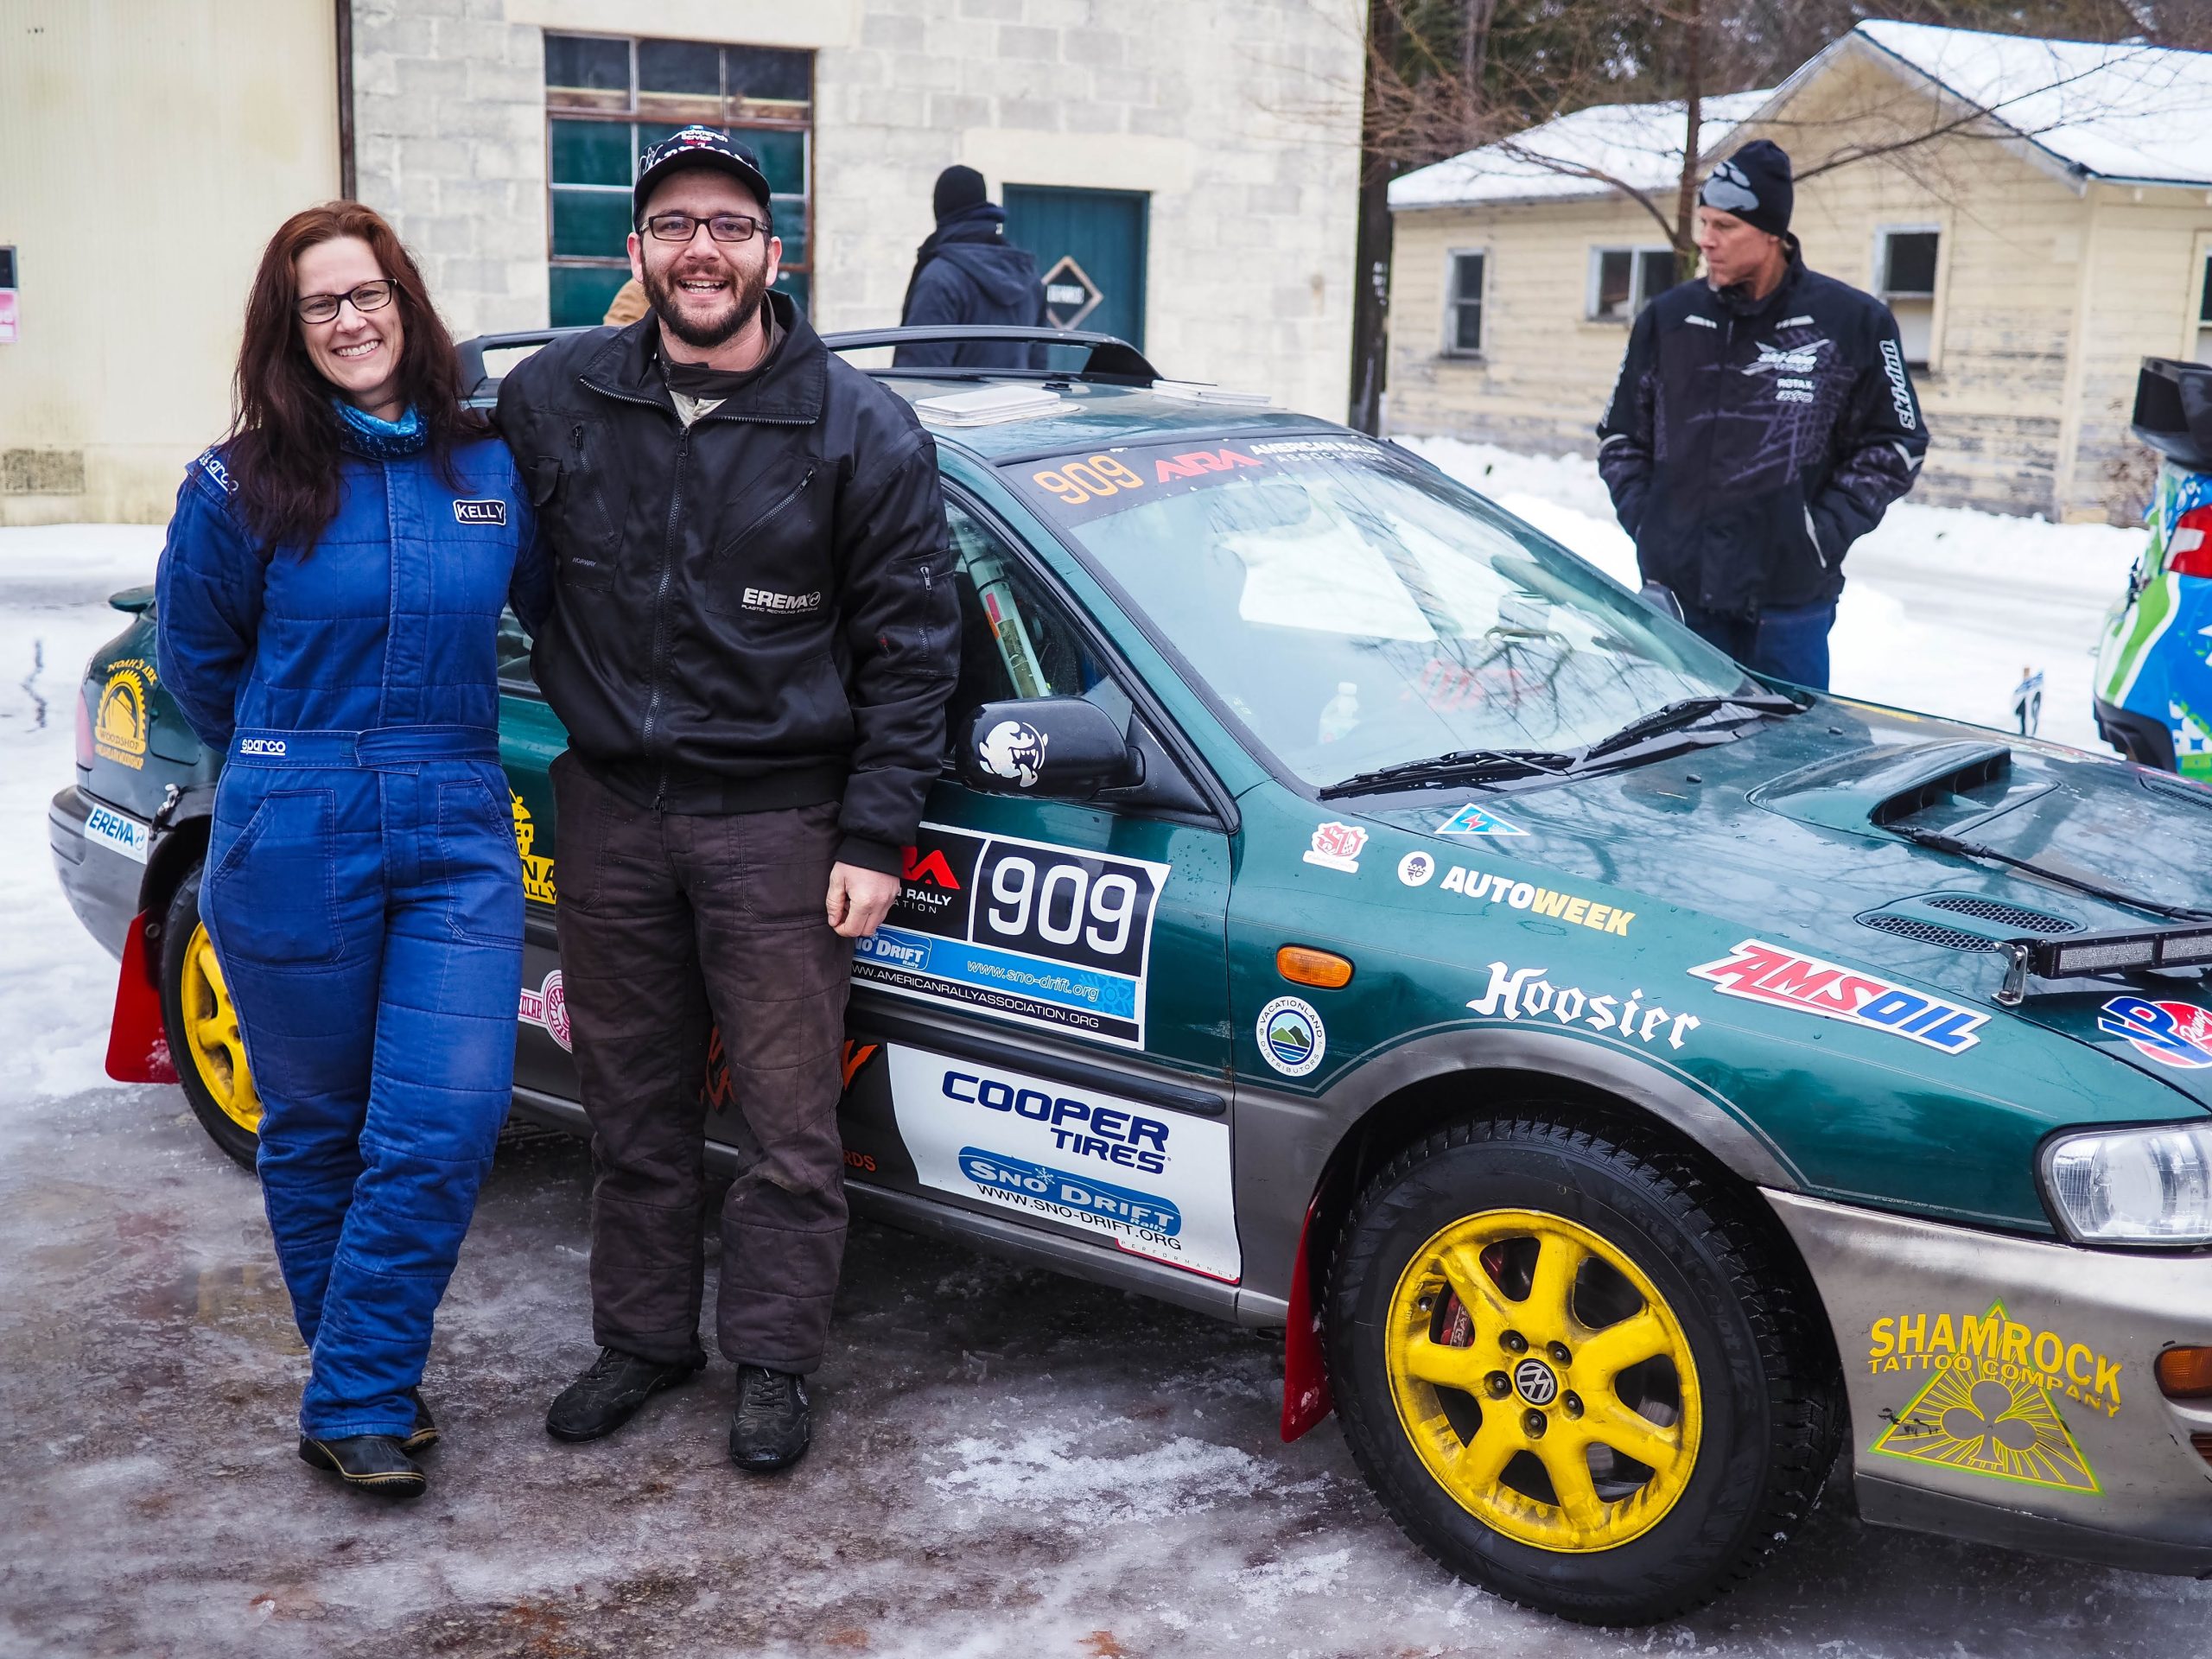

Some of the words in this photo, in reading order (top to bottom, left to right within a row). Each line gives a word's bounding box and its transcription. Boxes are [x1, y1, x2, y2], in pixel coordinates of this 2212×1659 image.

[1033, 454, 1145, 505] 909
[1249, 442, 1340, 455] AMERICAN
[457, 505, 505, 519] KELLY
[743, 588, 808, 609] EREMA
[142, 665, 157, 686] ARK
[99, 731, 139, 750] WOODSHOP
[240, 738, 286, 756] sparco
[89, 808, 134, 847] EREMA
[906, 888, 952, 906] RALLY
[988, 856, 1138, 955] 909
[1440, 866, 1637, 937] AUTOWEEK
[855, 938, 873, 952] NO
[902, 959, 919, 969] Rally
[850, 963, 1100, 1028] WW.AMERICANRALLYASSOCIATION.ORG
[967, 961, 1100, 1002] www.sno-drift.org
[1706, 944, 1979, 1048] AMSOIL
[1261, 1000, 1323, 1038] VACATIONLAND
[1466, 961, 1701, 1049] Hoosier
[1261, 1040, 1319, 1074] DISTRIBUTORS
[942, 1071, 1170, 1153] COOPER
[1050, 1128, 1169, 1175] TIRES
[969, 1160, 1048, 1192] SNO
[976, 1183, 1182, 1251] WWW.SNO-DRIFT.ORG
[1130, 1217, 1167, 1233] Rally
[1869, 1313, 2122, 1404] SHAMROCK
[1867, 1353, 1973, 1375] TATTOO
[1982, 1359, 2120, 1418] COMPANY
